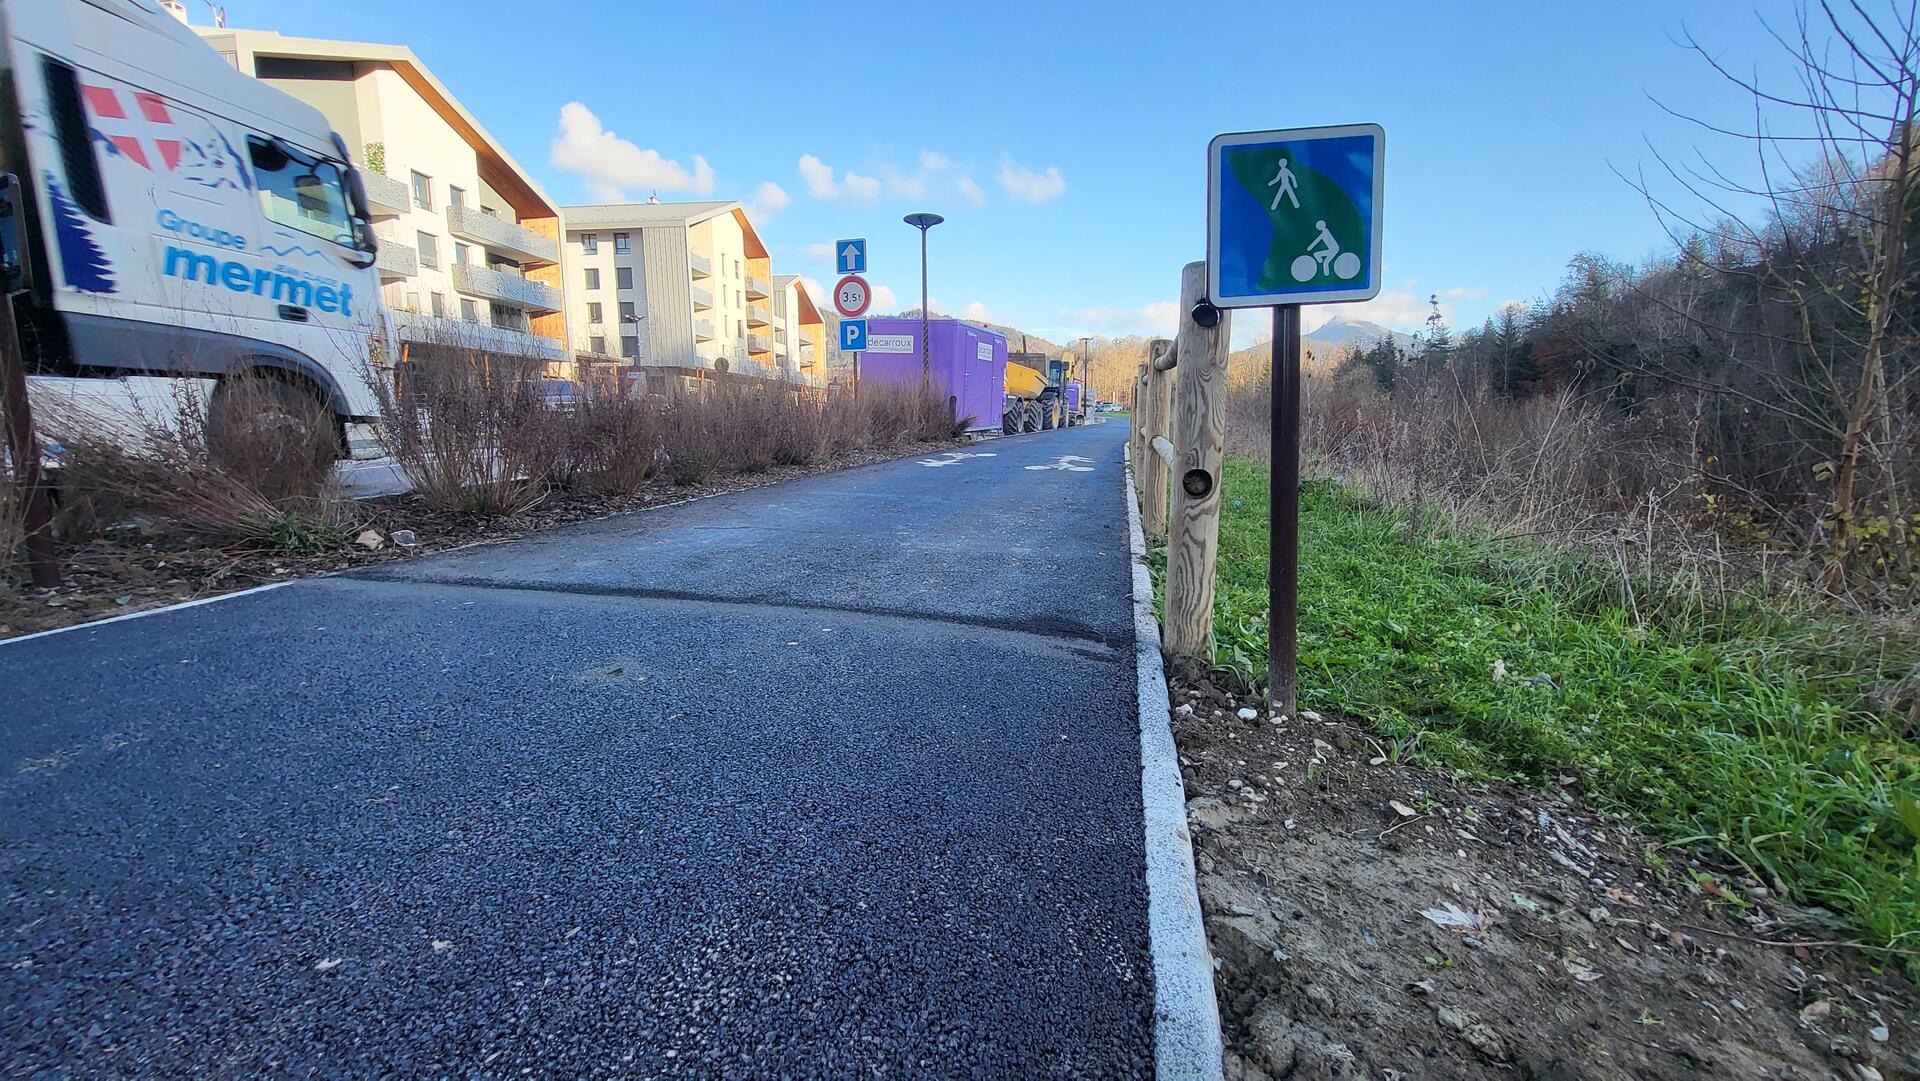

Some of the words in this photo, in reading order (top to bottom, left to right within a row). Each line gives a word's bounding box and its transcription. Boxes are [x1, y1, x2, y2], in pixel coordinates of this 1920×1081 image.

[157, 208, 247, 249] Groupe
[164, 246, 352, 317] mermet
[846, 325, 860, 346] P
[867, 337, 912, 347] decarroux
